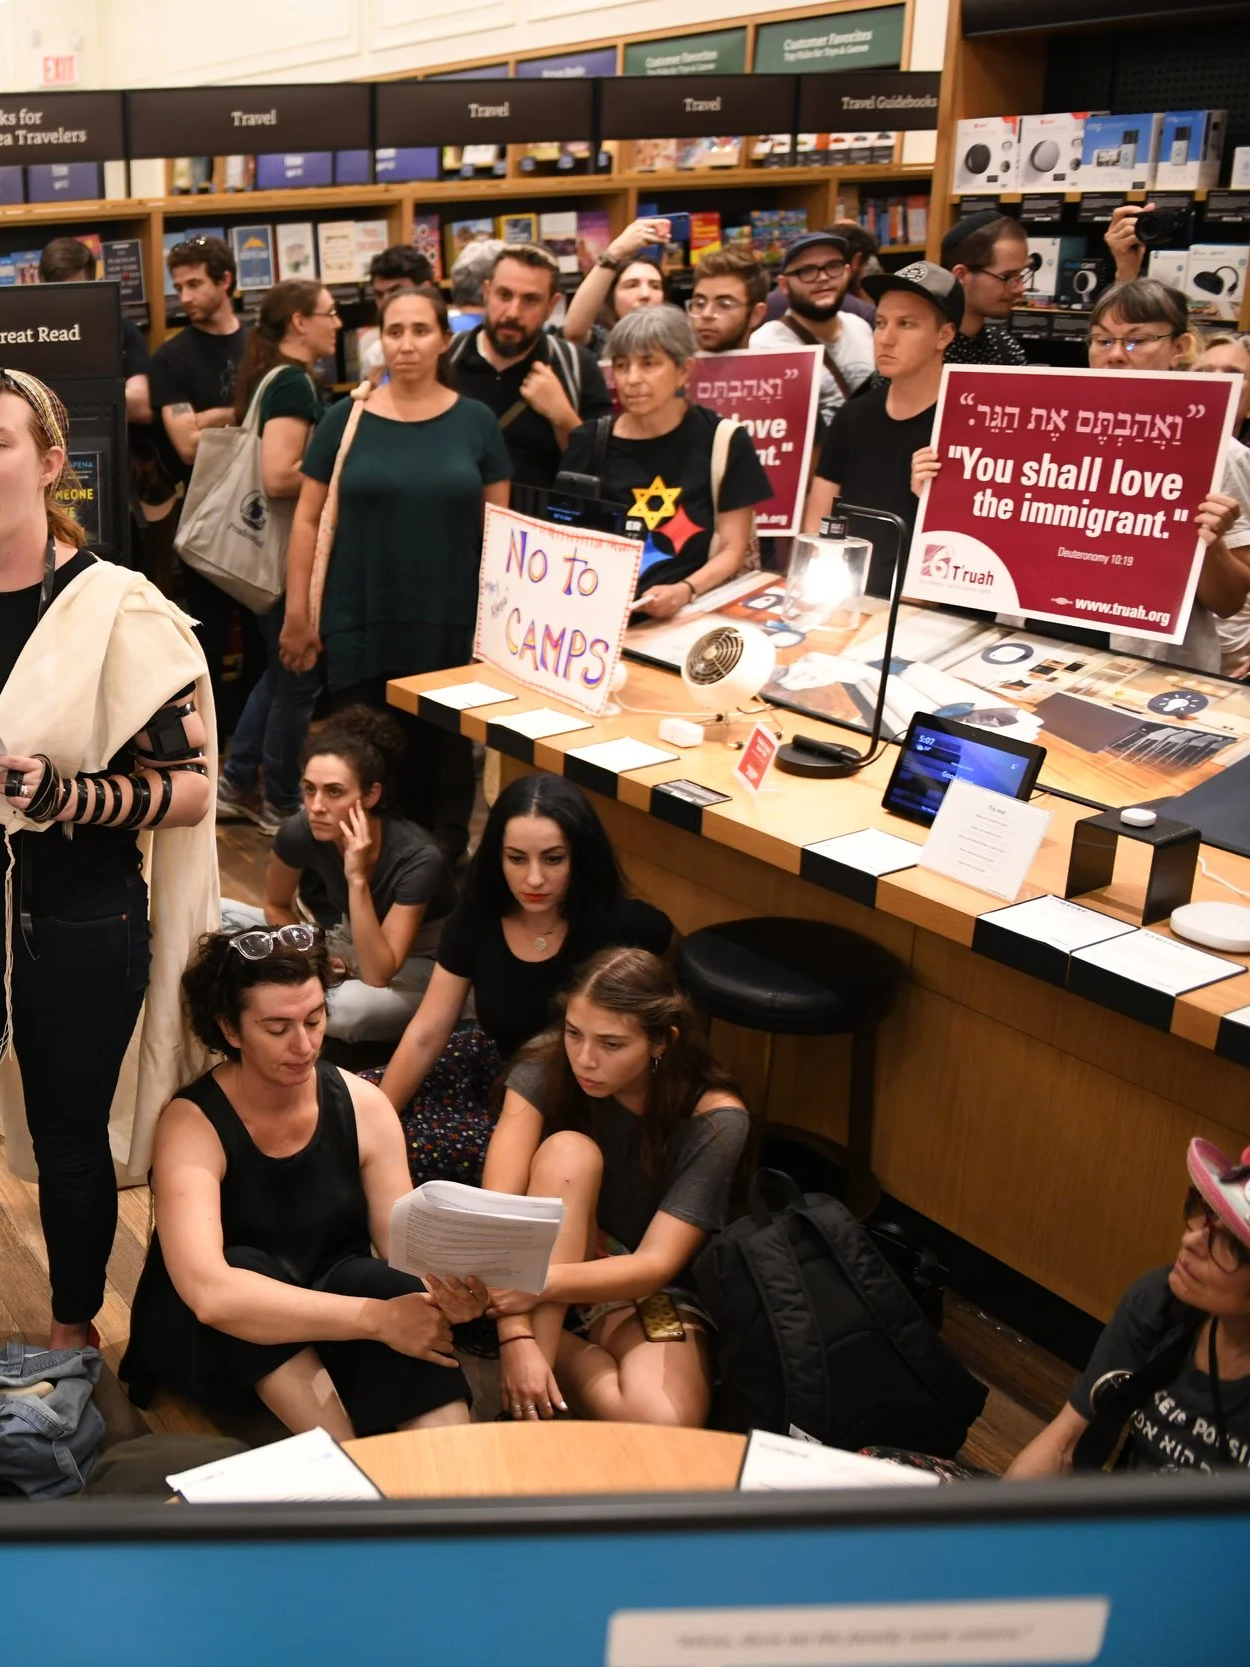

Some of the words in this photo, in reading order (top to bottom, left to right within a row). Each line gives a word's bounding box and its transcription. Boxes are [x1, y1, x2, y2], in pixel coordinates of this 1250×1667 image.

[44, 57, 75, 82] EXIT
[468, 102, 510, 118] Travel
[685, 96, 722, 112] Travel
[842, 97, 876, 110] Travel
[877, 94, 938, 109] Guidebooks
[19, 109, 43, 125] for
[231, 109, 277, 127] Travel
[15, 128, 87, 146] Travelers
[37, 324, 81, 342] Read
[948, 445, 1014, 484] "You
[1020, 453, 1103, 492] shall
[1109, 459, 1184, 500] love
[54, 488, 95, 501] MEONE
[973, 488, 1014, 520] the
[1020, 493, 1189, 540] immigrant."
[1057, 547, 1110, 565] Deuteronomy
[1110, 553, 1134, 567] 10:19
[953, 565, 995, 586] T'ruah
[1075, 597, 1170, 627] www.truah.org
[505, 607, 610, 690] CAMPS
[918, 734, 936, 746] 5:07
